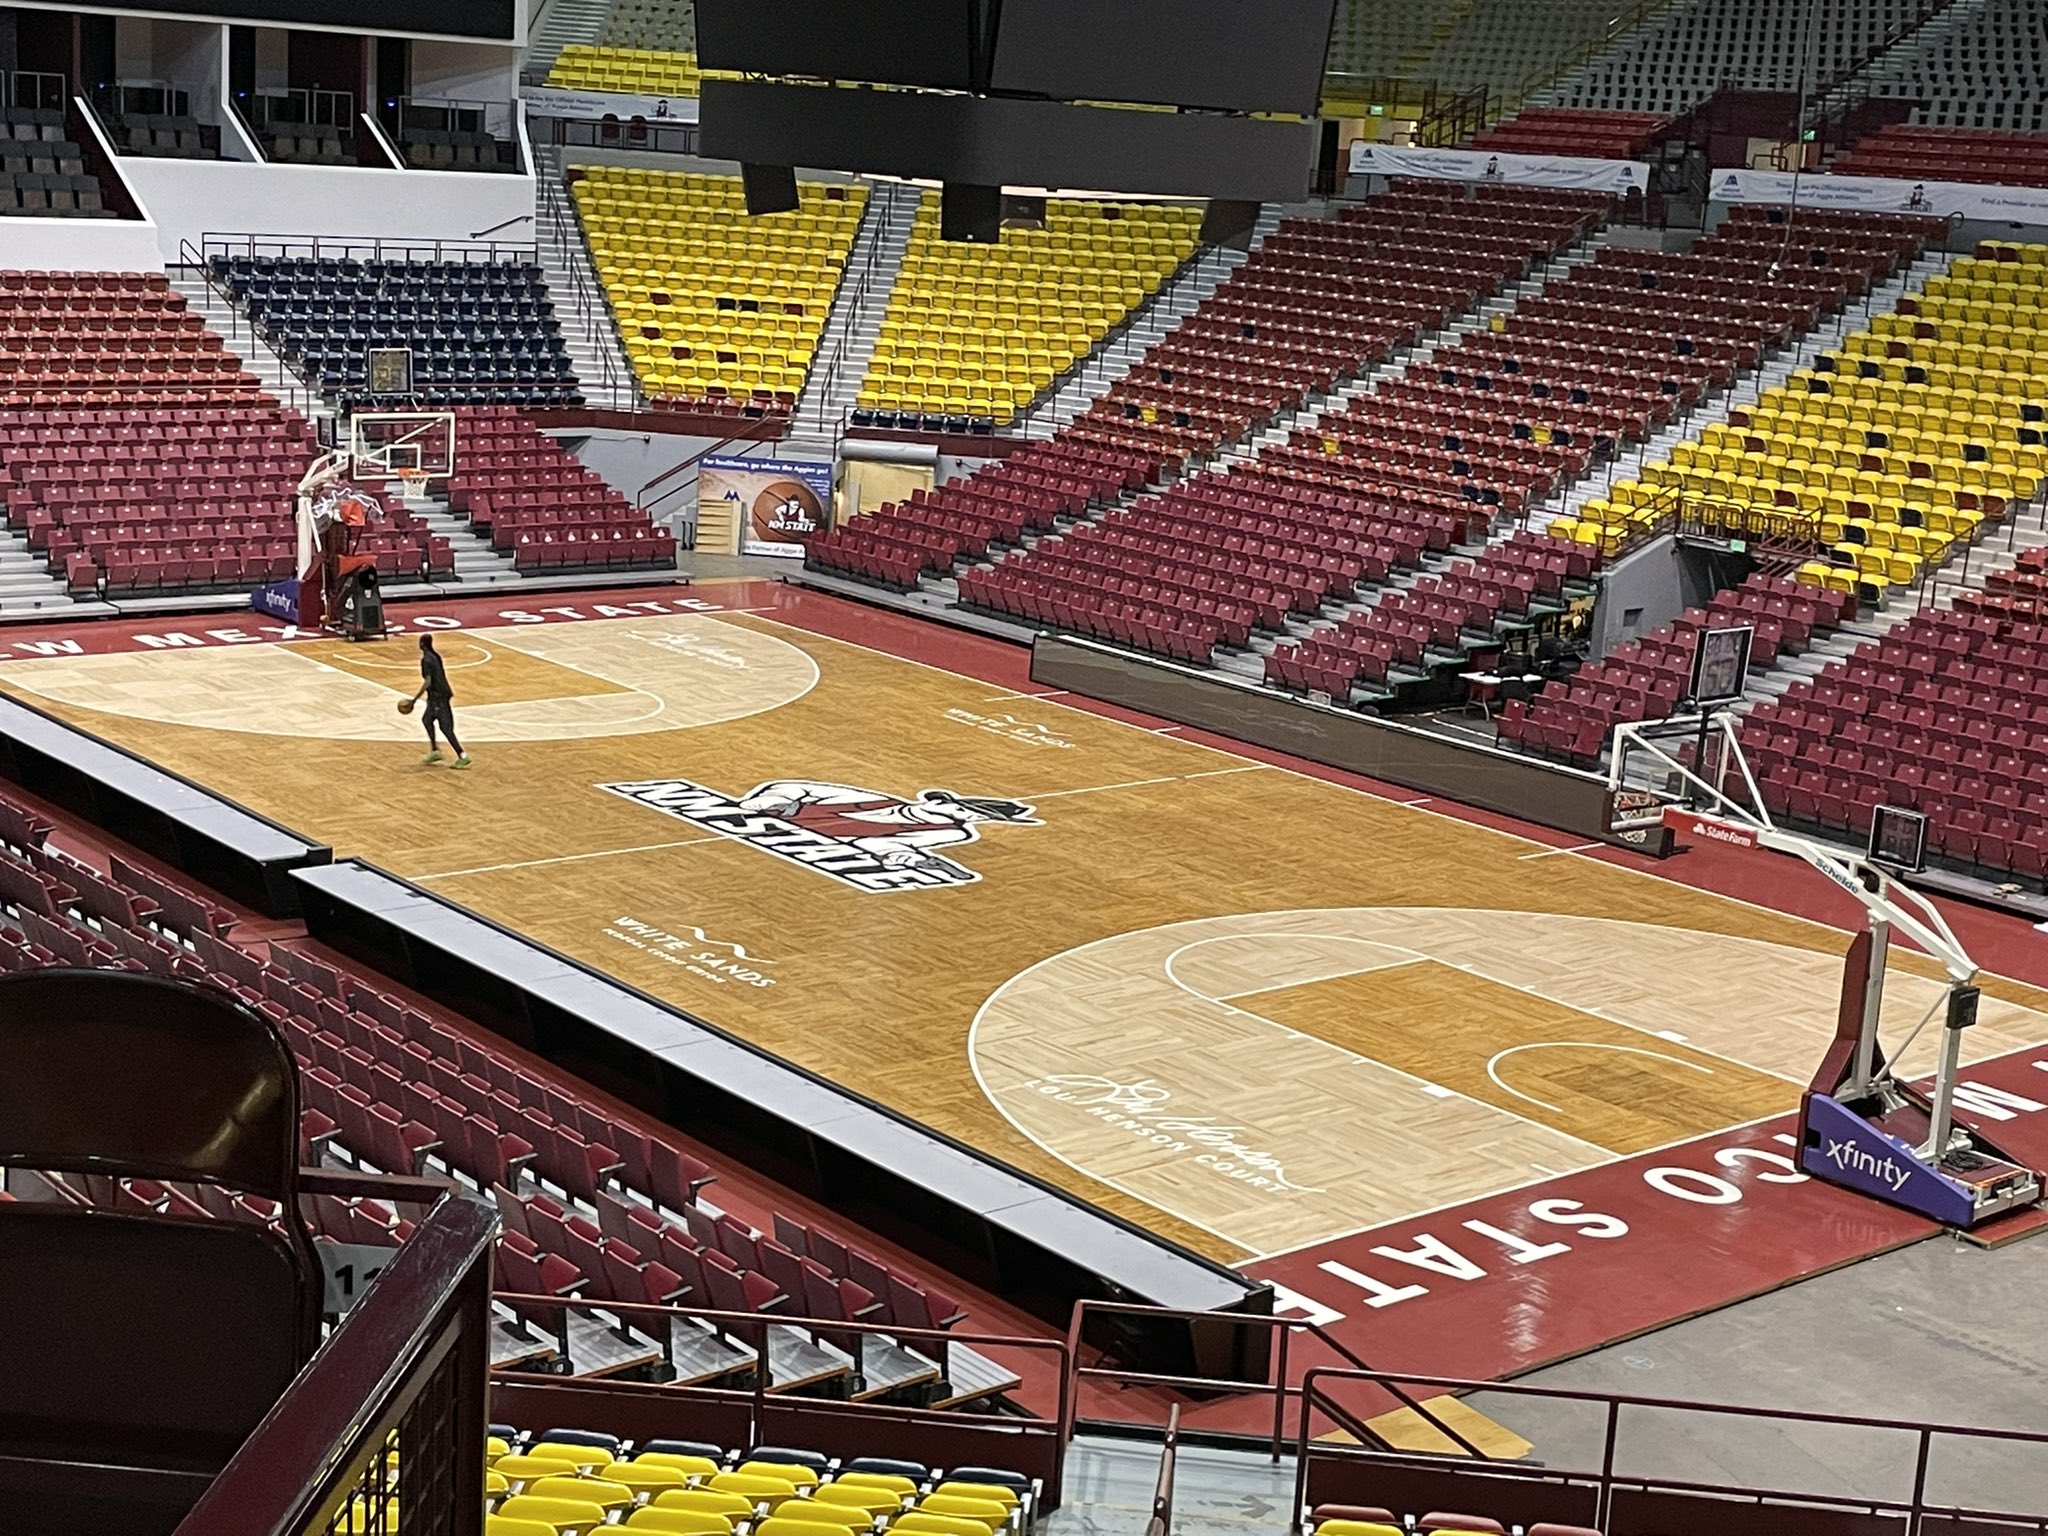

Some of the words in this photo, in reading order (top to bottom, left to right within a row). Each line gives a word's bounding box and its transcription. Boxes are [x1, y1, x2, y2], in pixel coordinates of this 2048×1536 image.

[265, 589, 291, 612] xfinity
[498, 598, 725, 624] STATE
[613, 916, 693, 950] WHITE
[690, 952, 777, 988] SANDS
[1024, 1079, 1077, 1101] LOU
[1085, 1106, 1192, 1152] HENSON
[1194, 1154, 1289, 1192] COURT
[1826, 1138, 1912, 1192] xfinity
[1260, 1198, 1630, 1334] STATE
